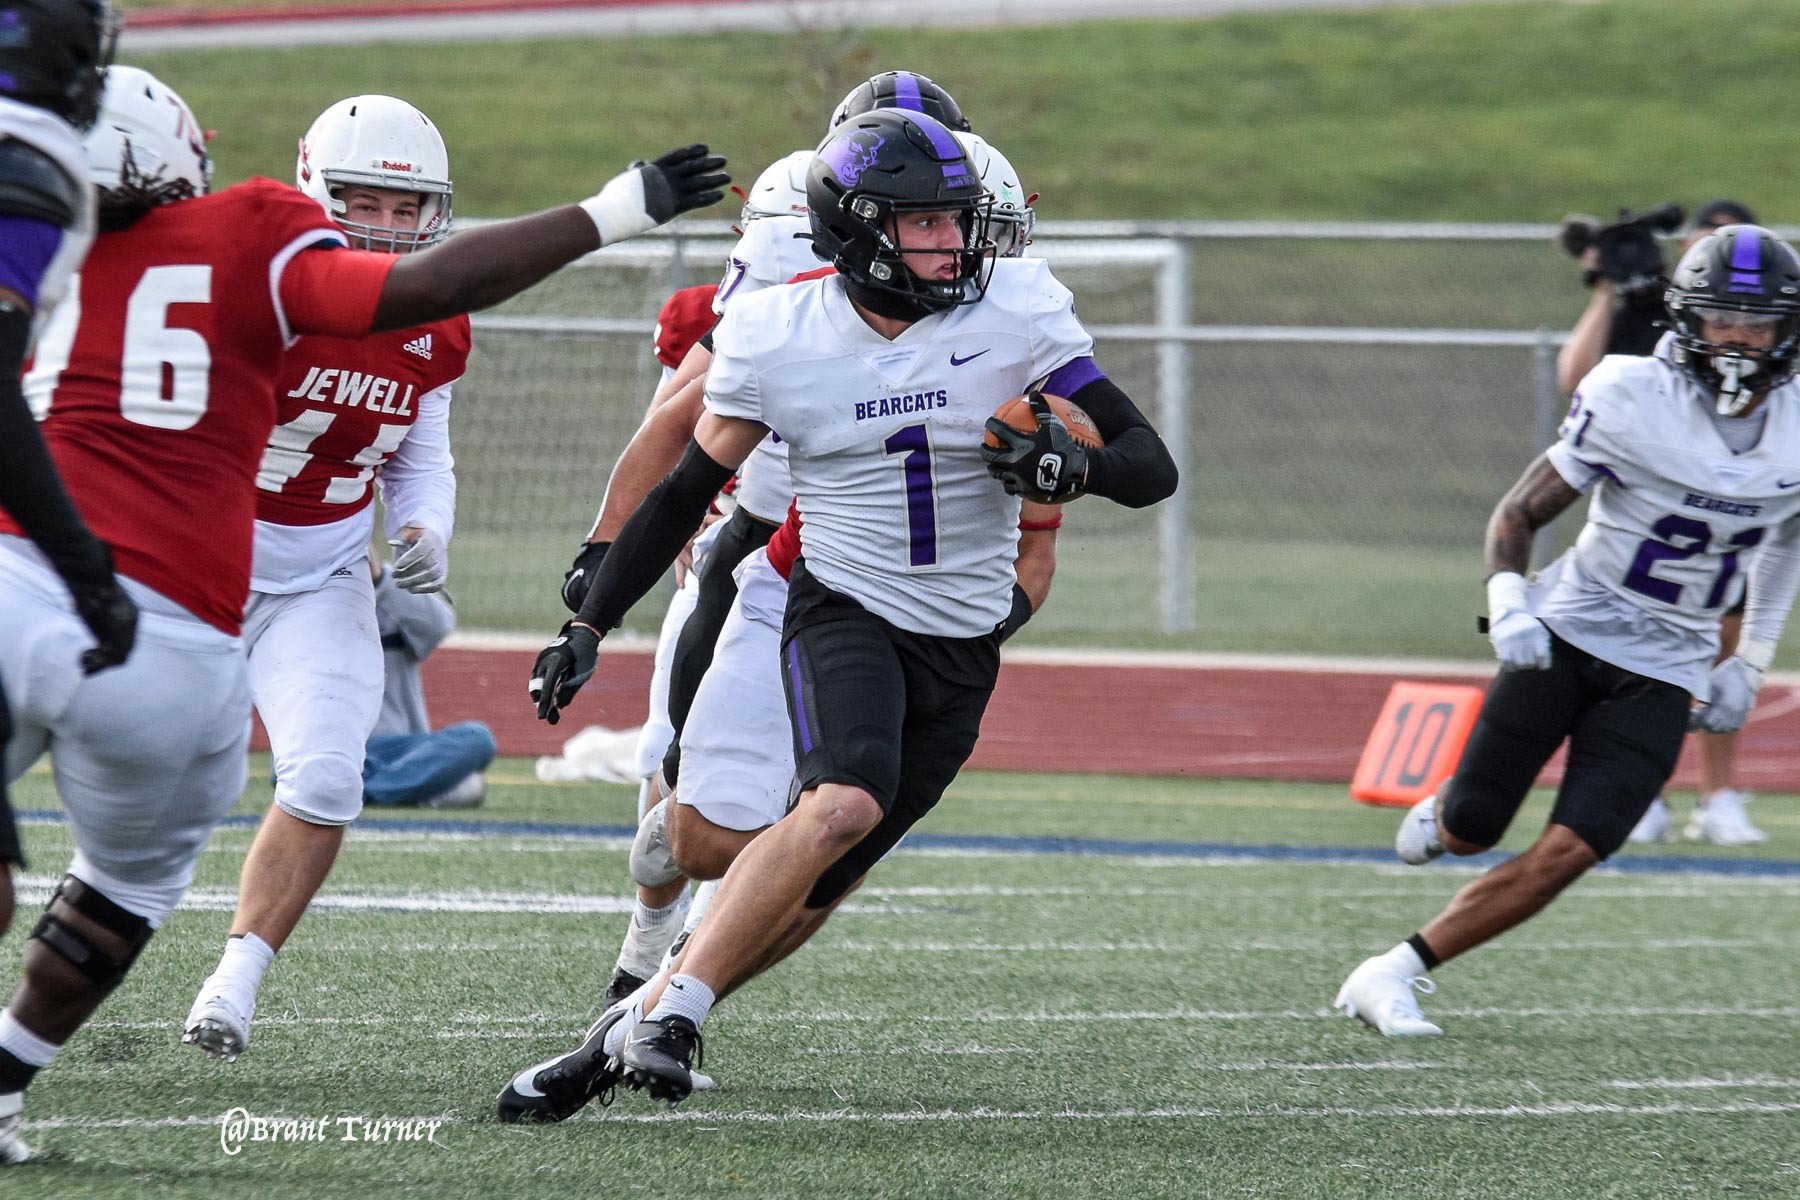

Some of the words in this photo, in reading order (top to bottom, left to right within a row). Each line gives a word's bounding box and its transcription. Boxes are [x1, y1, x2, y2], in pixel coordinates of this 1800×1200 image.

[403, 343, 432, 360] adidas
[287, 366, 414, 417] JEWELL
[854, 389, 947, 421] BEARCATS
[882, 421, 939, 570] 1
[1623, 513, 1767, 609] 21
[1374, 702, 1454, 788] 10
